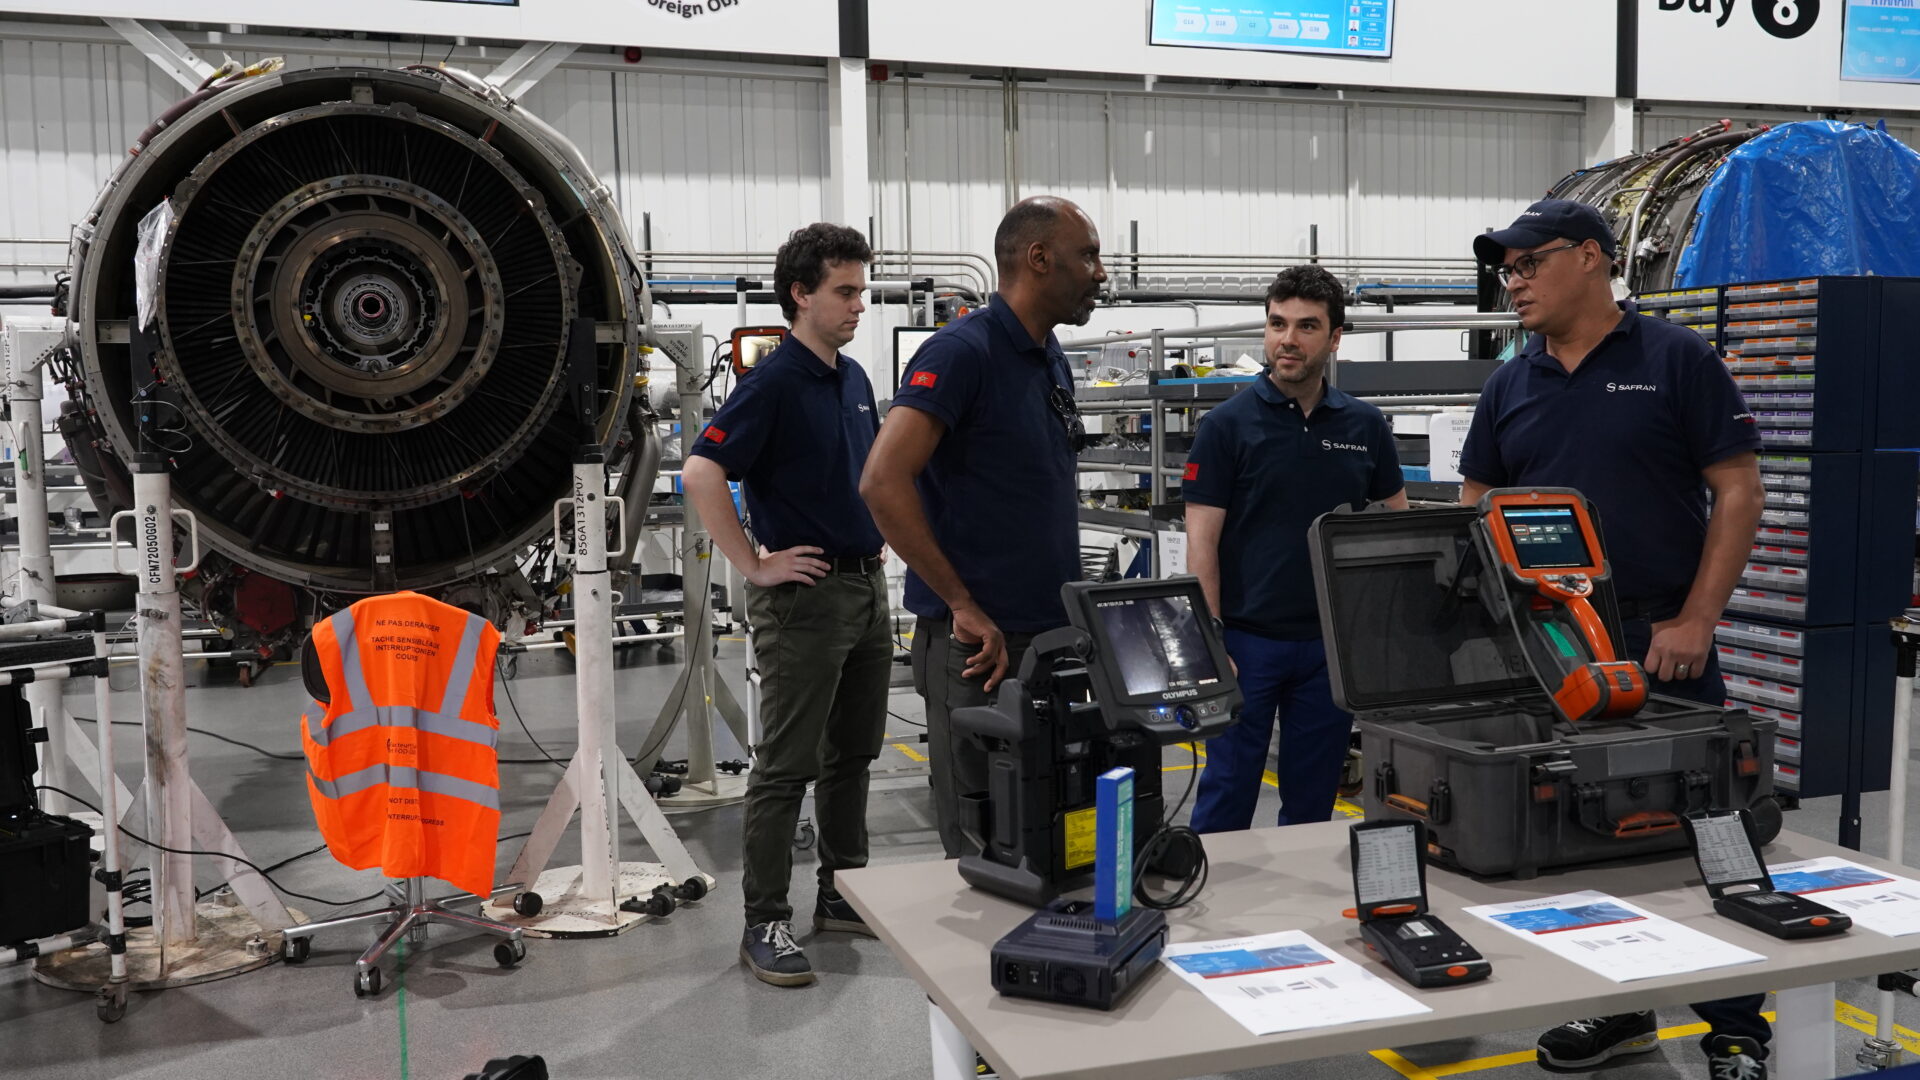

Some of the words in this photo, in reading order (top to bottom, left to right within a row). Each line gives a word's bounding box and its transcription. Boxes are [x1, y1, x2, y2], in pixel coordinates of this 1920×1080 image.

[648, 0, 703, 18] oreign
[1772, 0, 1799, 26] 8
[1618, 384, 1656, 392] SAFRAN
[1333, 442, 1368, 452] SAFRAN
[144, 516, 161, 584] CFM72050G02
[1162, 689, 1198, 700] OLYMPUS
